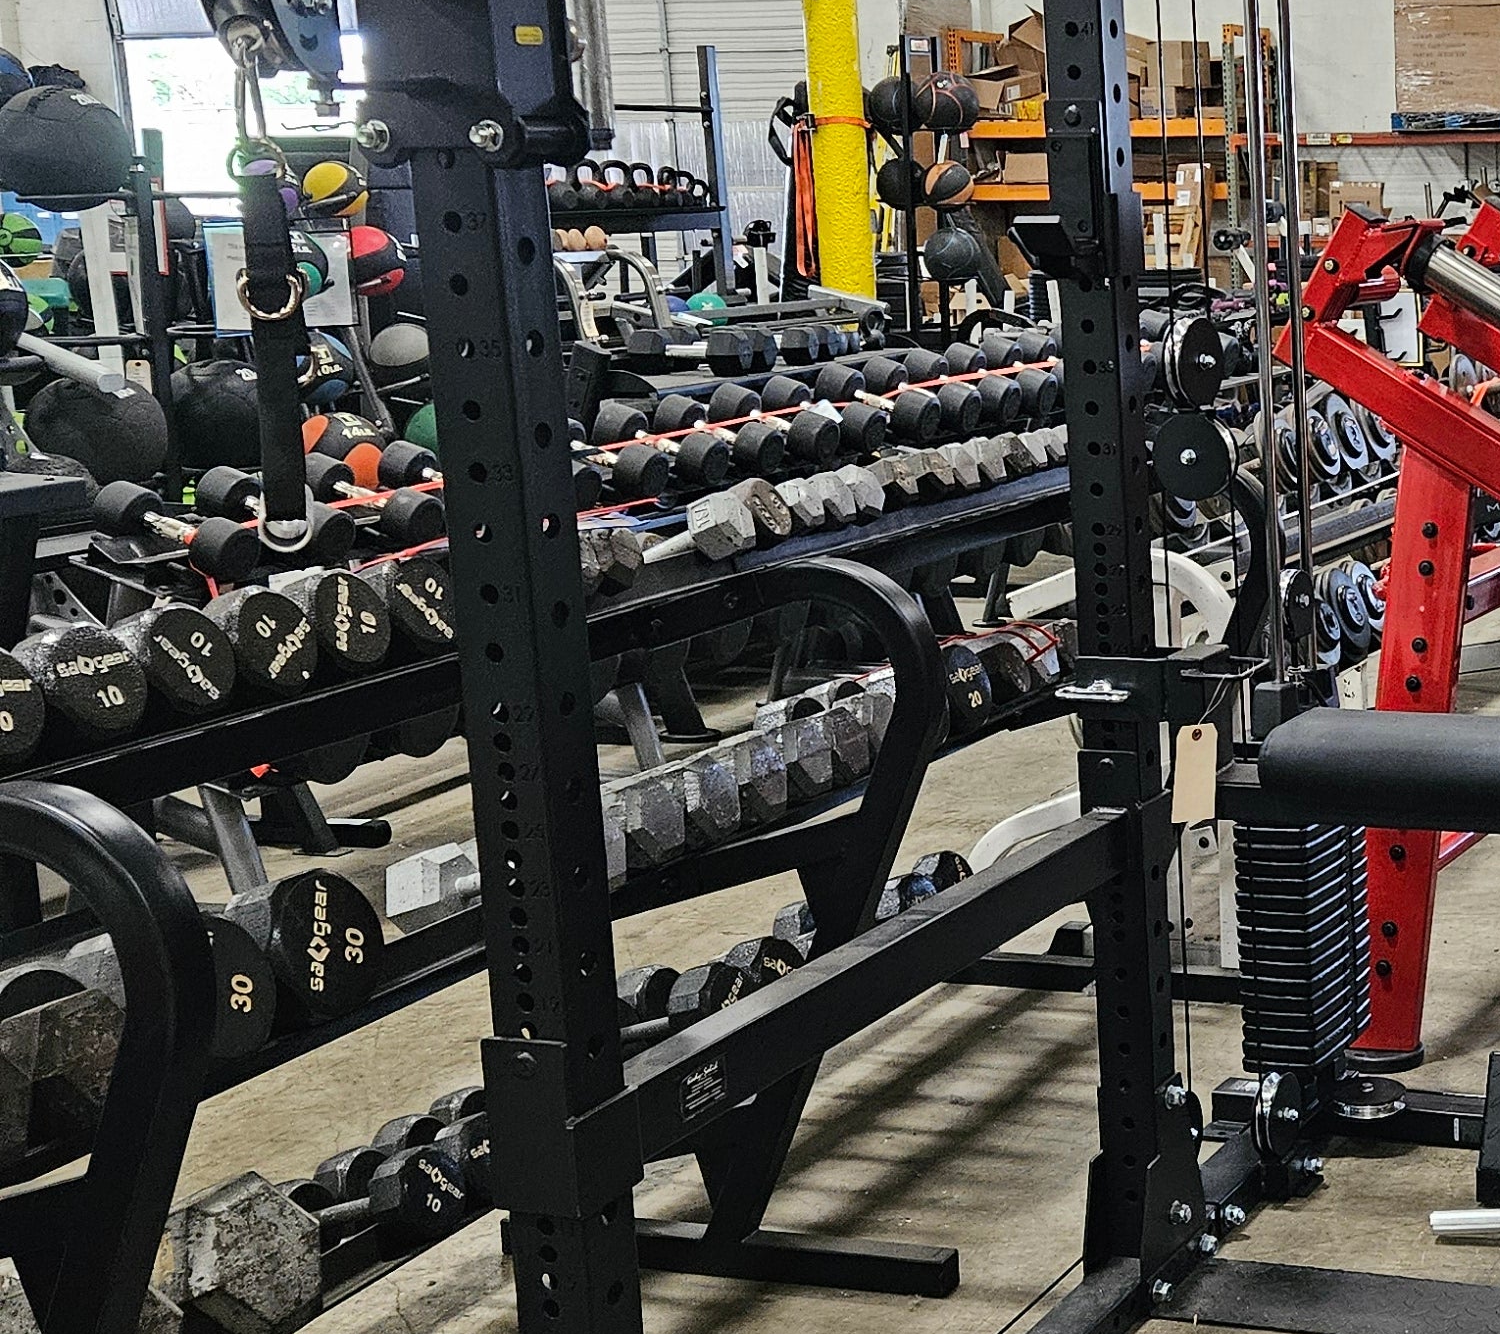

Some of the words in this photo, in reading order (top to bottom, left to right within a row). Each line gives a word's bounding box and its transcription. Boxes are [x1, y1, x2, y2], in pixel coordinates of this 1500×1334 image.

[424, 577, 444, 601] 10
[255, 614, 277, 639] 10
[359, 610, 378, 635] 10
[190, 631, 214, 658] 10
[96, 684, 126, 709] 10
[967, 689, 983, 709] 20
[344, 927, 365, 965] 30
[230, 973, 254, 1014] 30
[426, 1192, 442, 1213] 10
